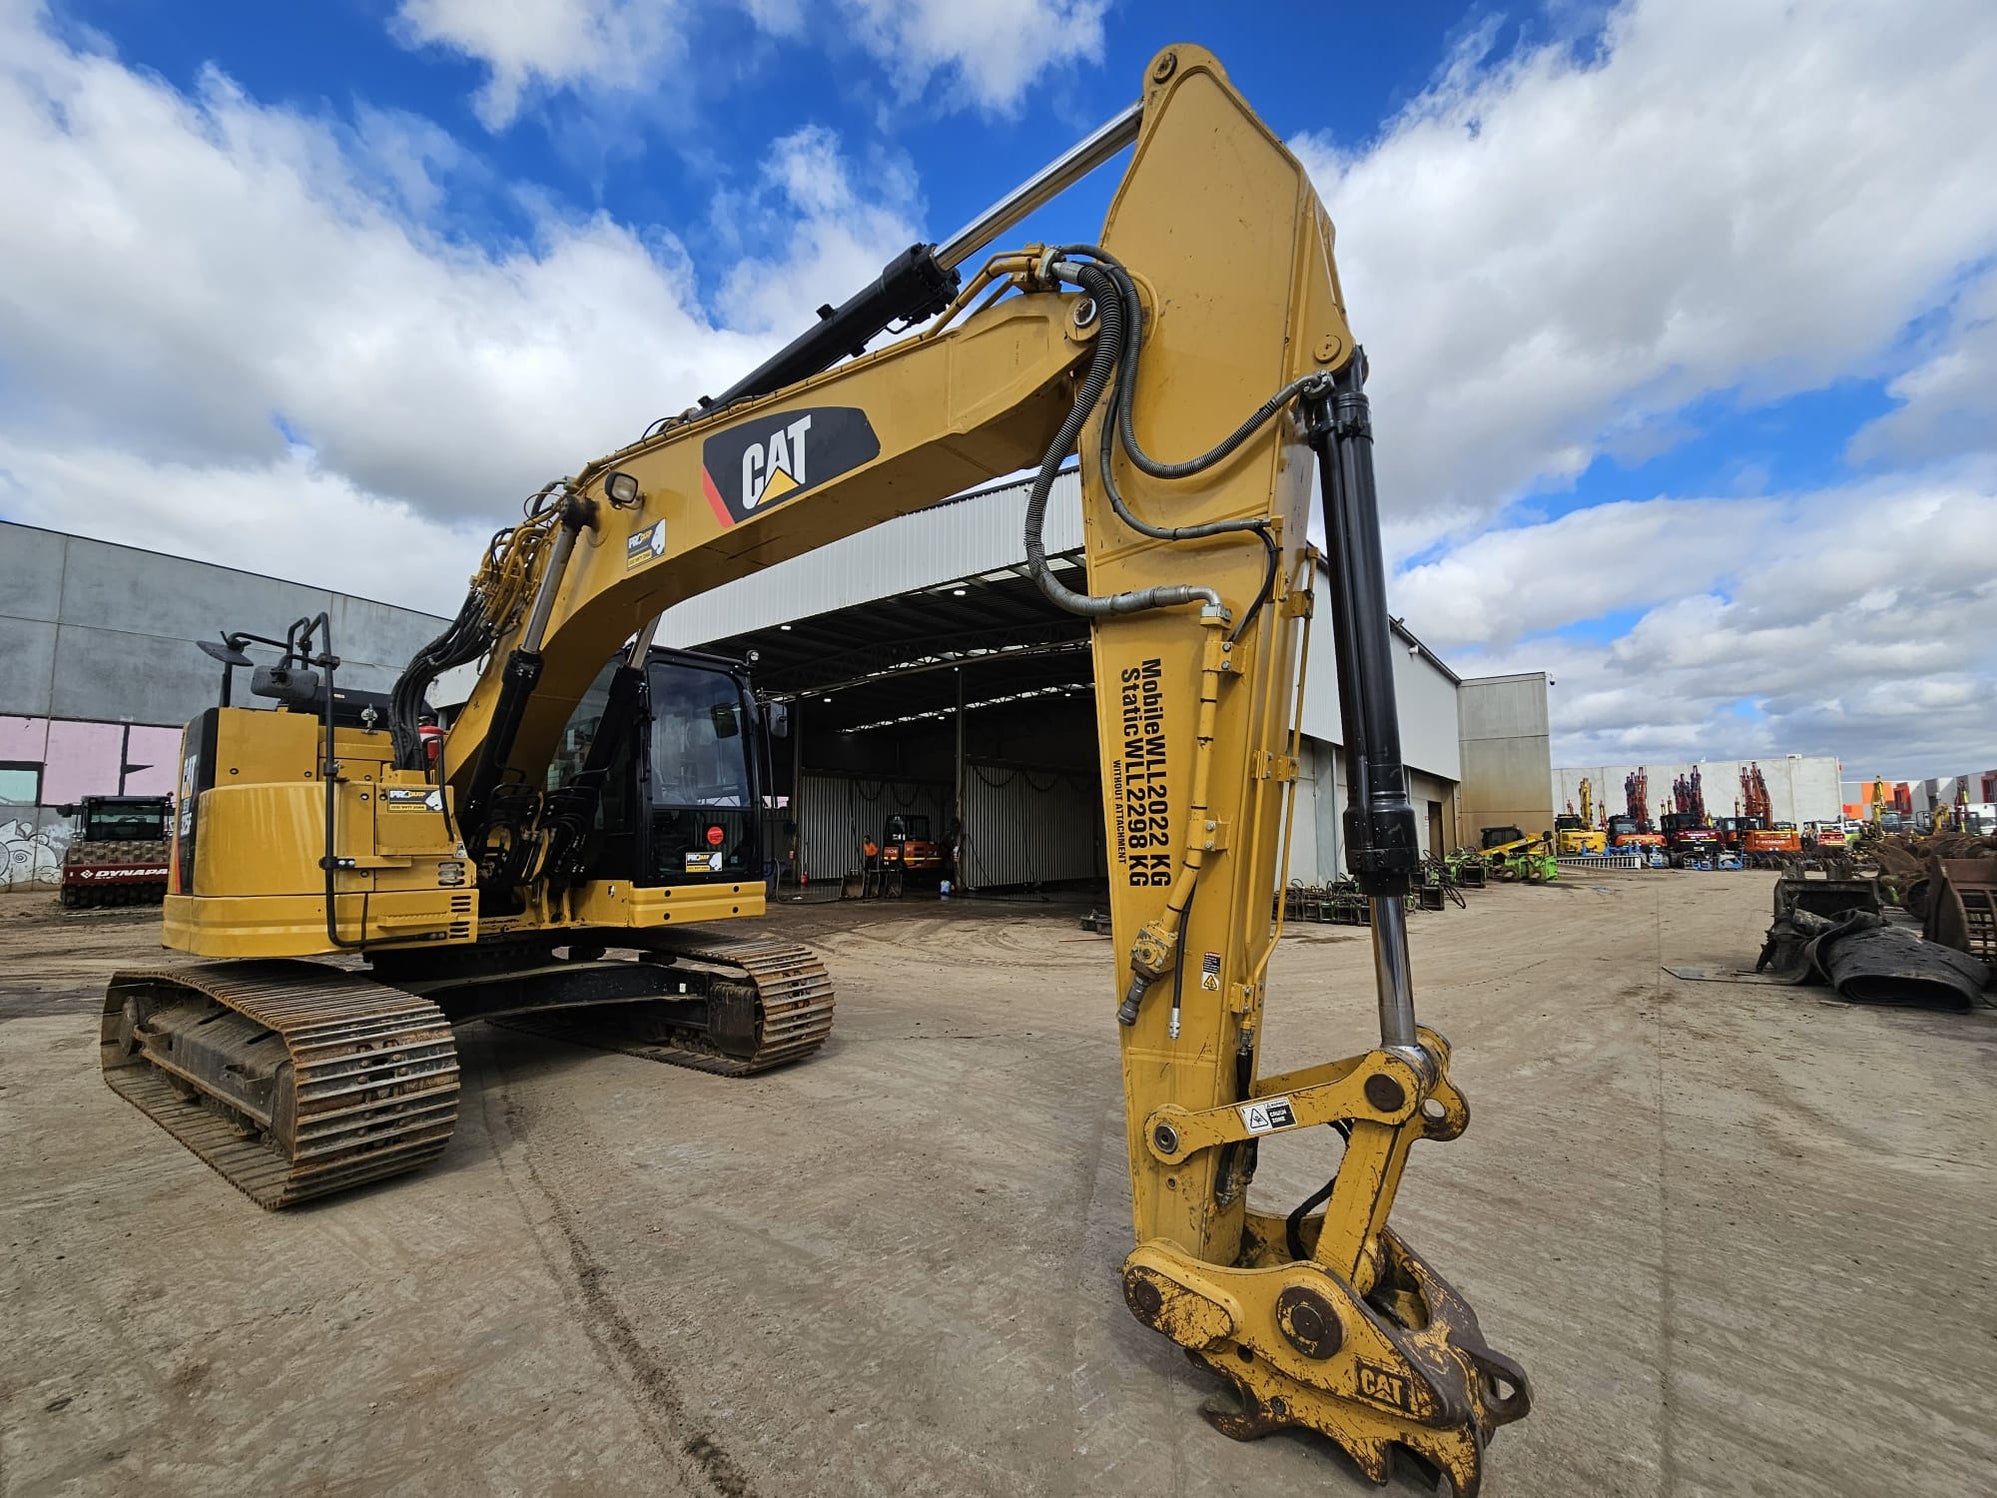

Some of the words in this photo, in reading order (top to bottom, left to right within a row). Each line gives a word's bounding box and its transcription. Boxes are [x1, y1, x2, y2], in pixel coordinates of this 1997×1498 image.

[742, 414, 812, 510] CAT
[1121, 668, 1143, 737] Static
[1142, 658, 1164, 735] Mobile
[1112, 759, 1123, 806] WITHOUT
[1124, 737, 1145, 786] WLL
[1145, 734, 1167, 784] WLL
[1115, 804, 1127, 864] ATTACHMENT
[1126, 788, 1148, 849] 2298
[1147, 784, 1170, 847] 2022
[95, 868, 168, 877] DYNAPA
[1128, 855, 1149, 887] KG
[1150, 854, 1172, 887] KG
[1361, 1368, 1403, 1406] CAT
